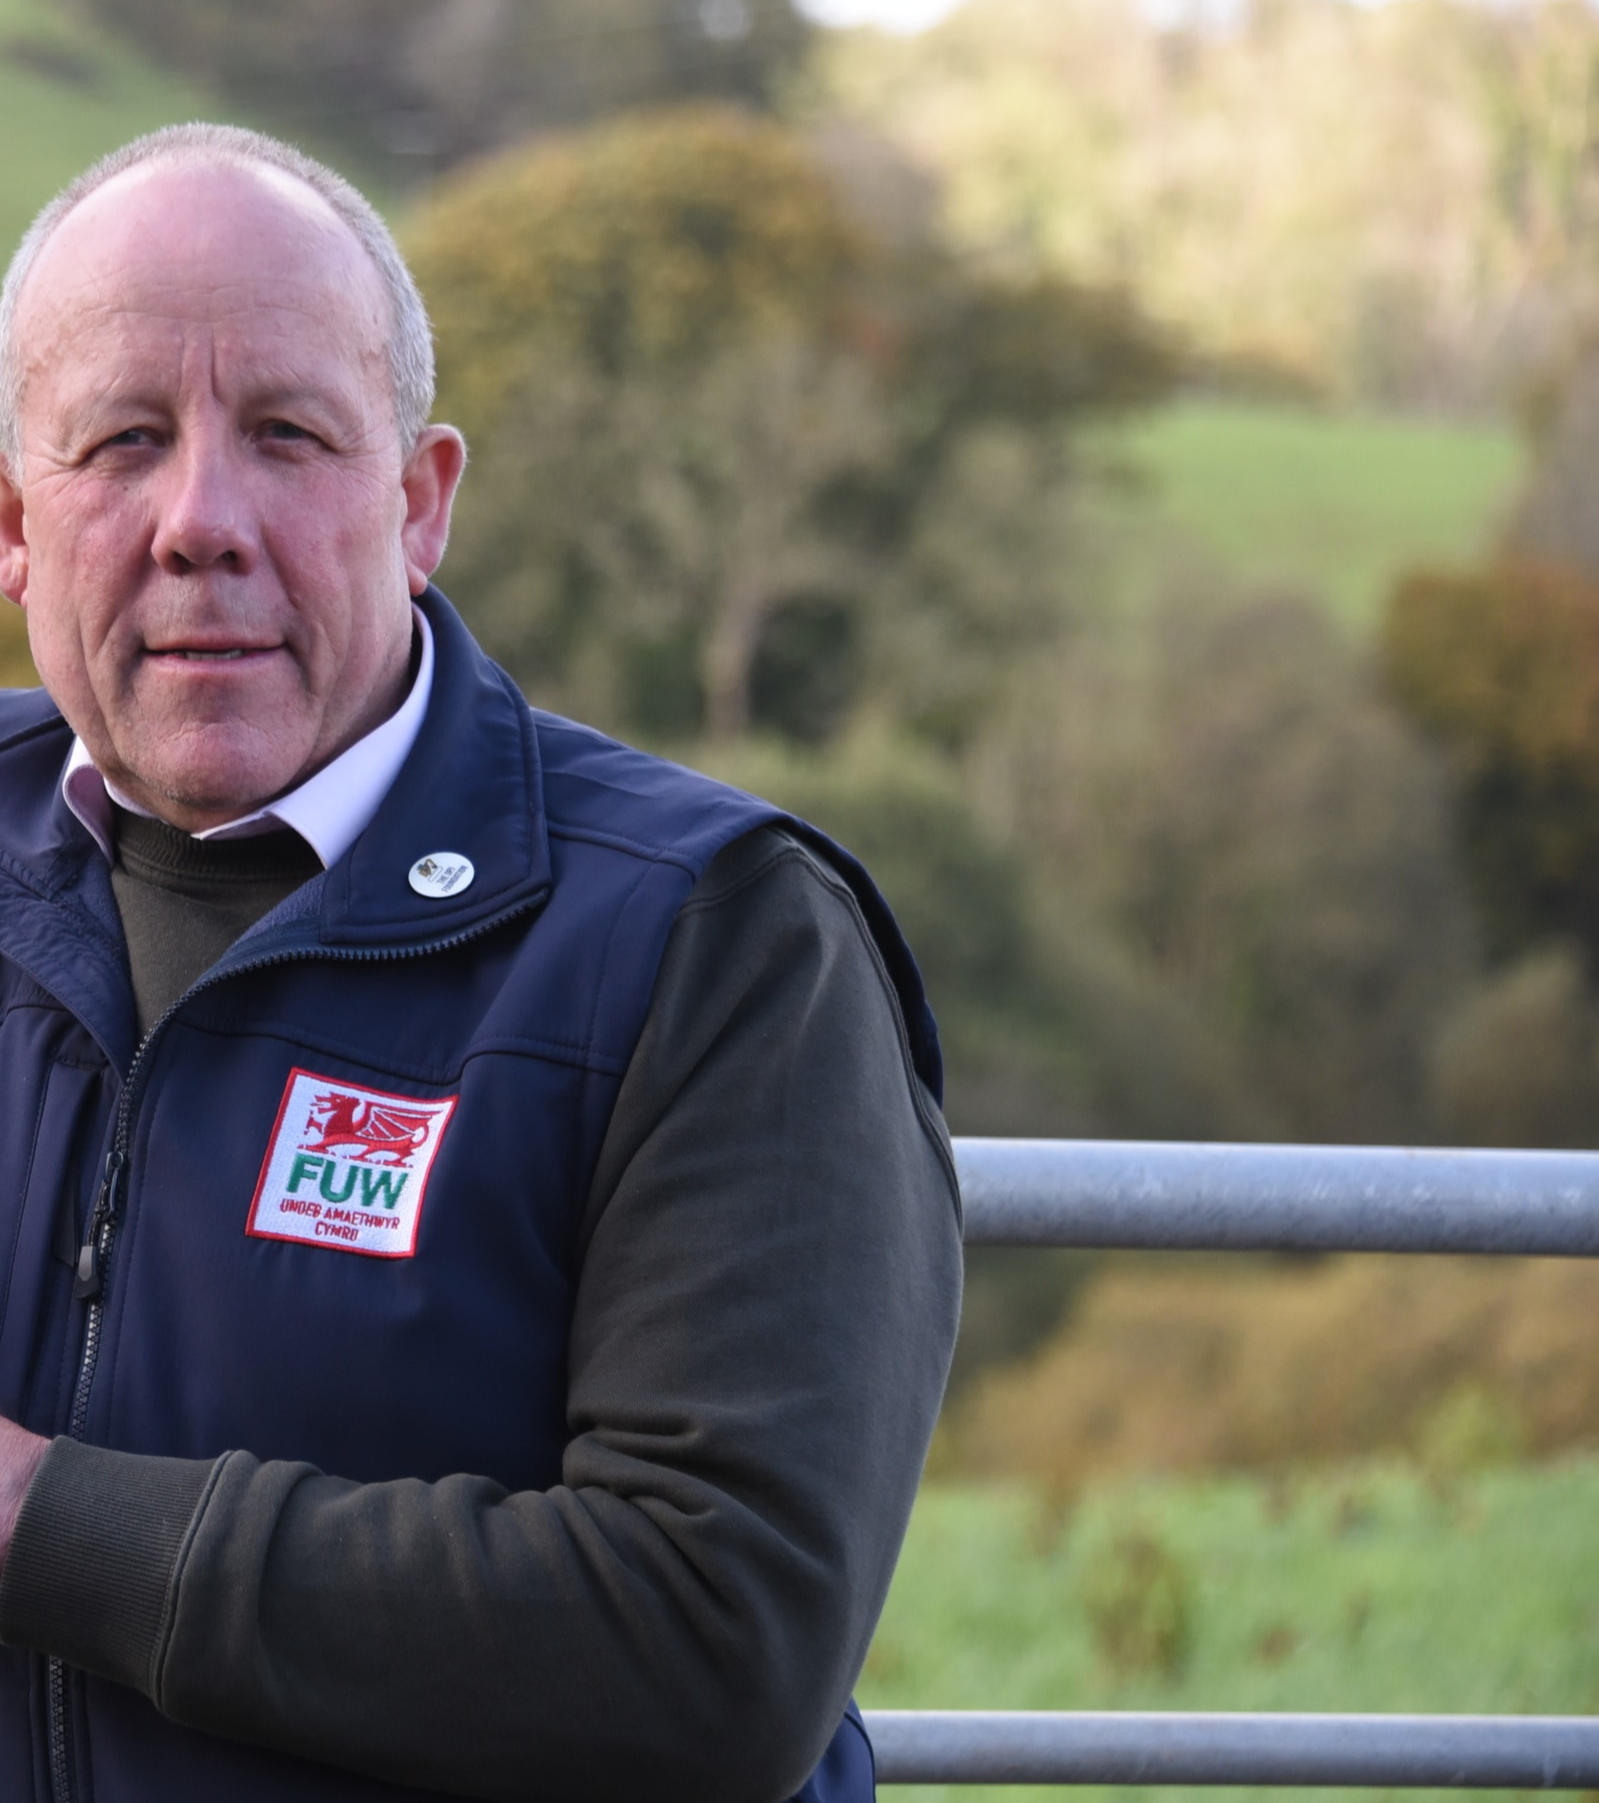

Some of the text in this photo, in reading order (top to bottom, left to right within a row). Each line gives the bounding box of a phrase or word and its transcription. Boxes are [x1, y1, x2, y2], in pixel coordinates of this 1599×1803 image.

[286, 1153, 409, 1209] FUW
[280, 1199, 400, 1230] UNDEB AMAETHWYR
[315, 1221, 360, 1241] CYMRU
